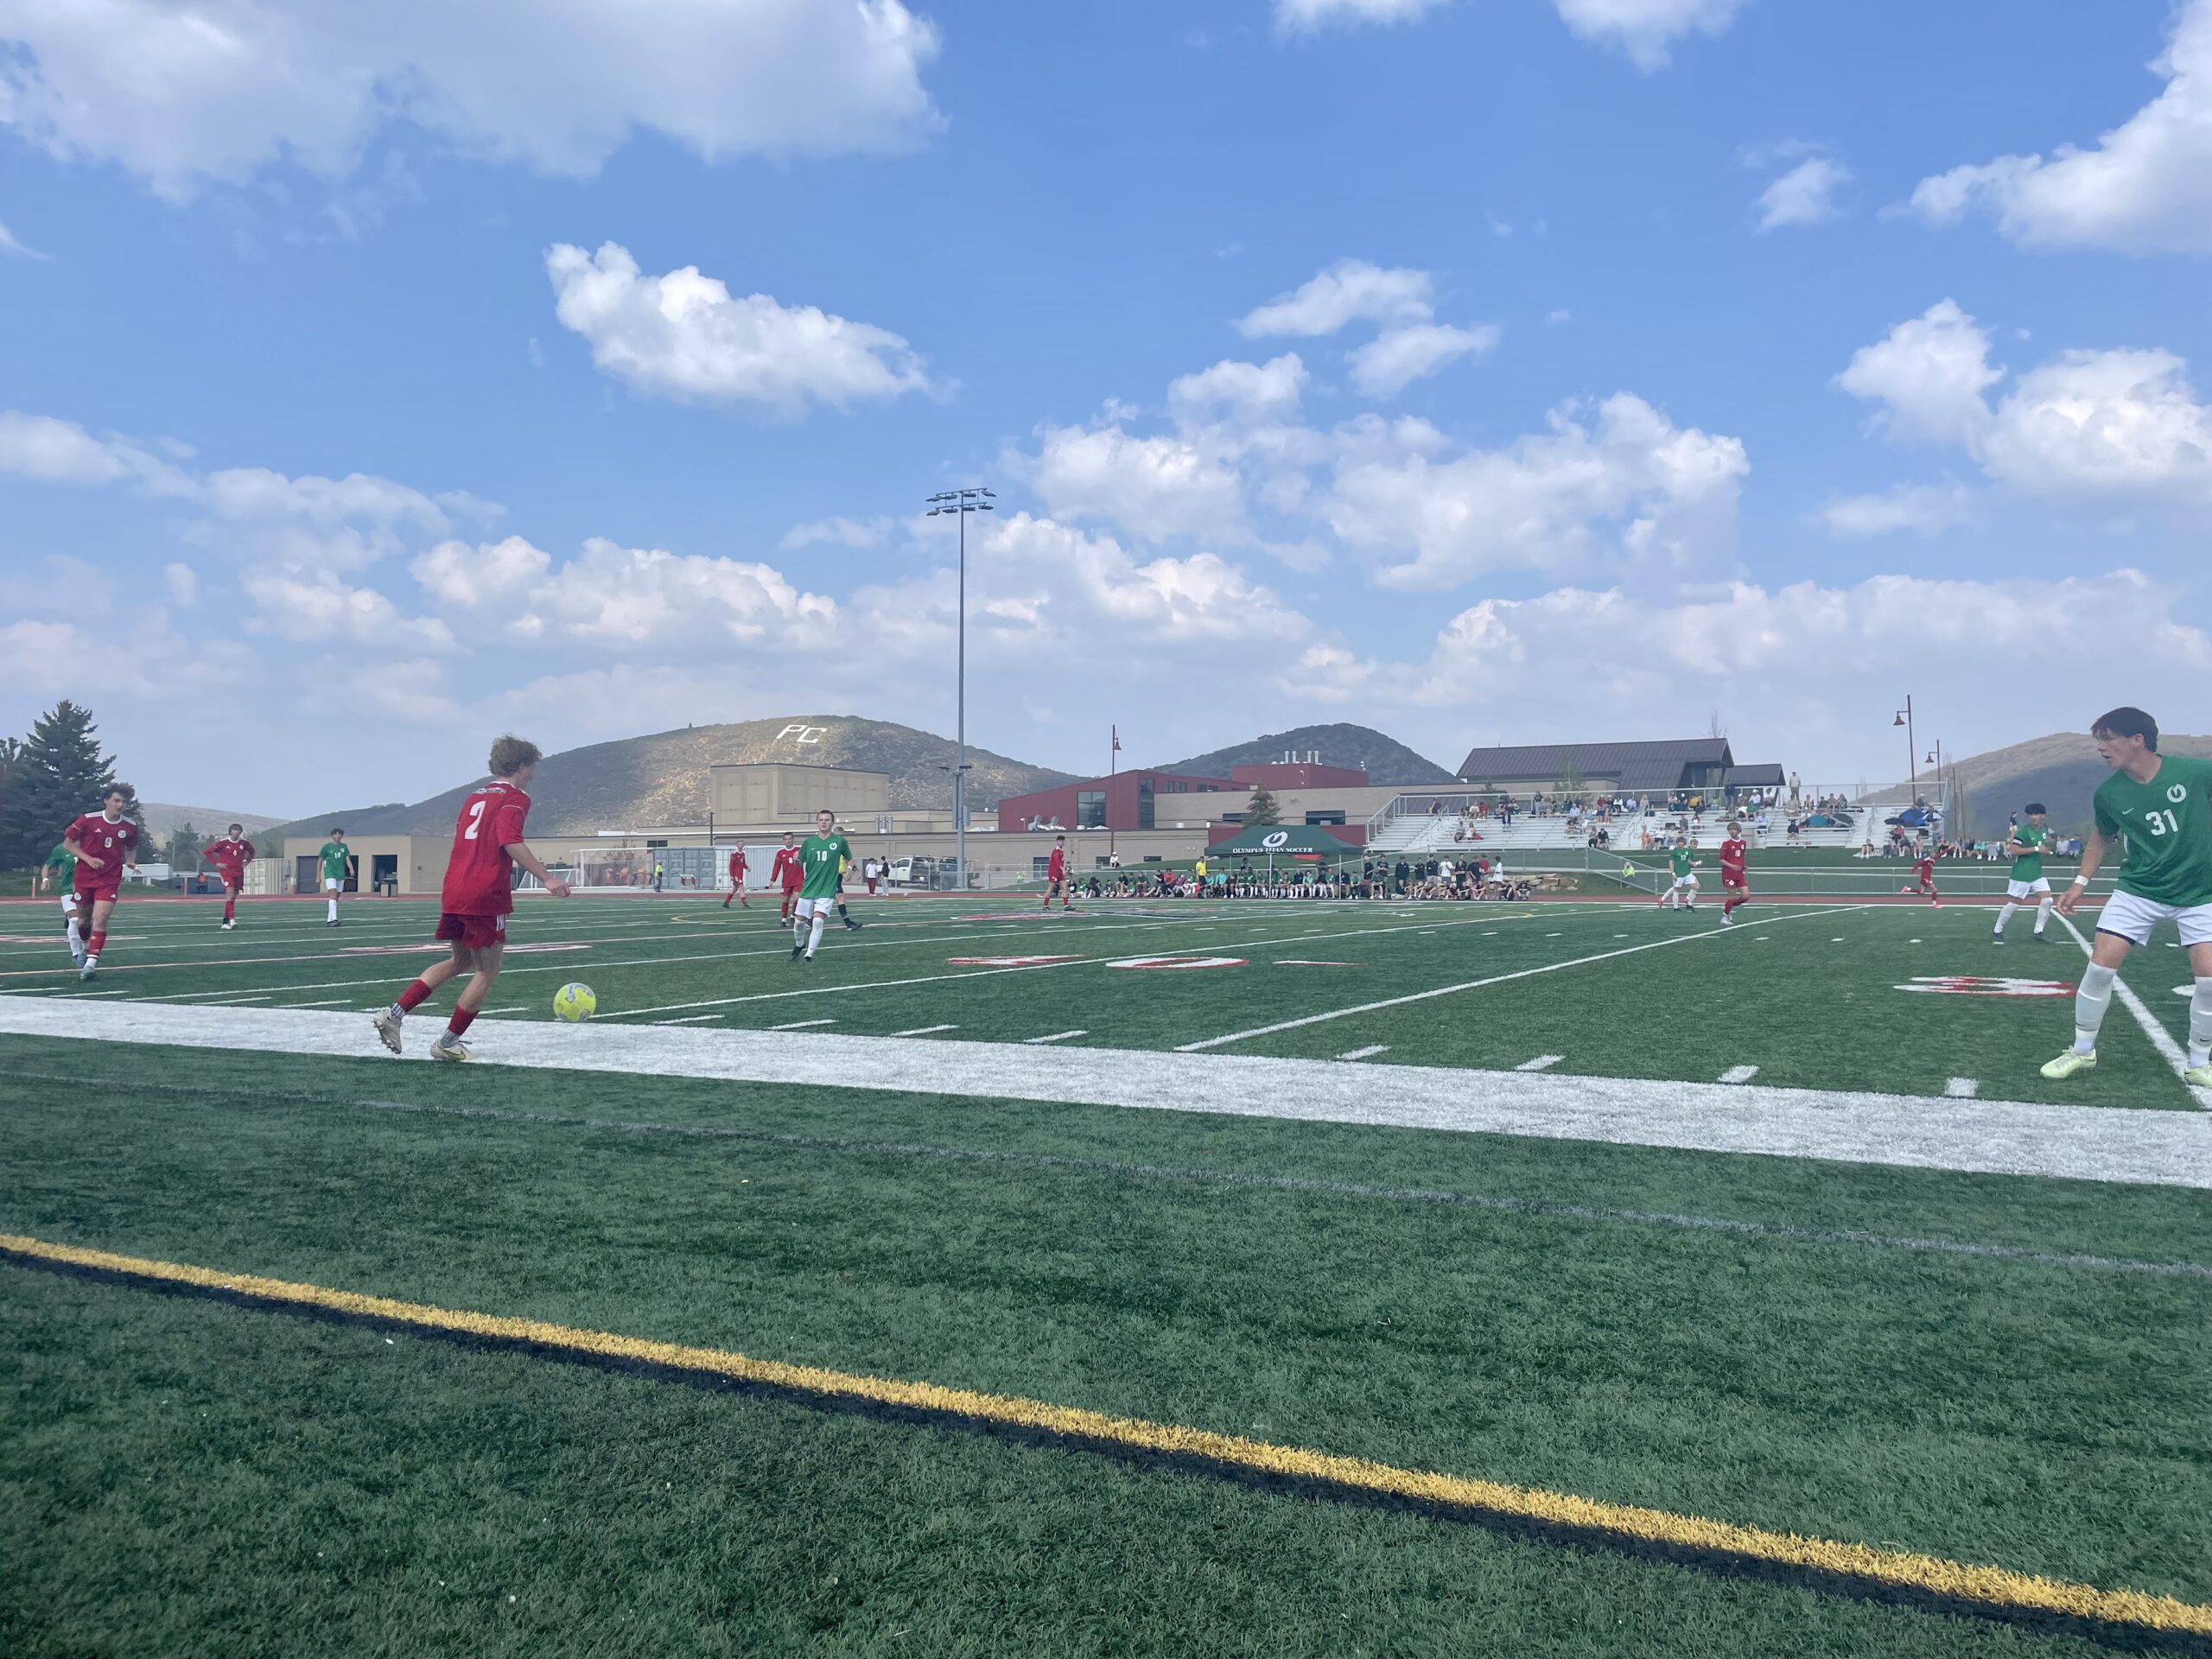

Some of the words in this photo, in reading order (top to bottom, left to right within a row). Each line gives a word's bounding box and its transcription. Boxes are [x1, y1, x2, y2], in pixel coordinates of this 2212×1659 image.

[776, 724, 828, 743] PC
[464, 800, 486, 840] 2
[2145, 809, 2178, 836] 31
[105, 836, 113, 848] 9
[817, 850, 828, 861] 10
